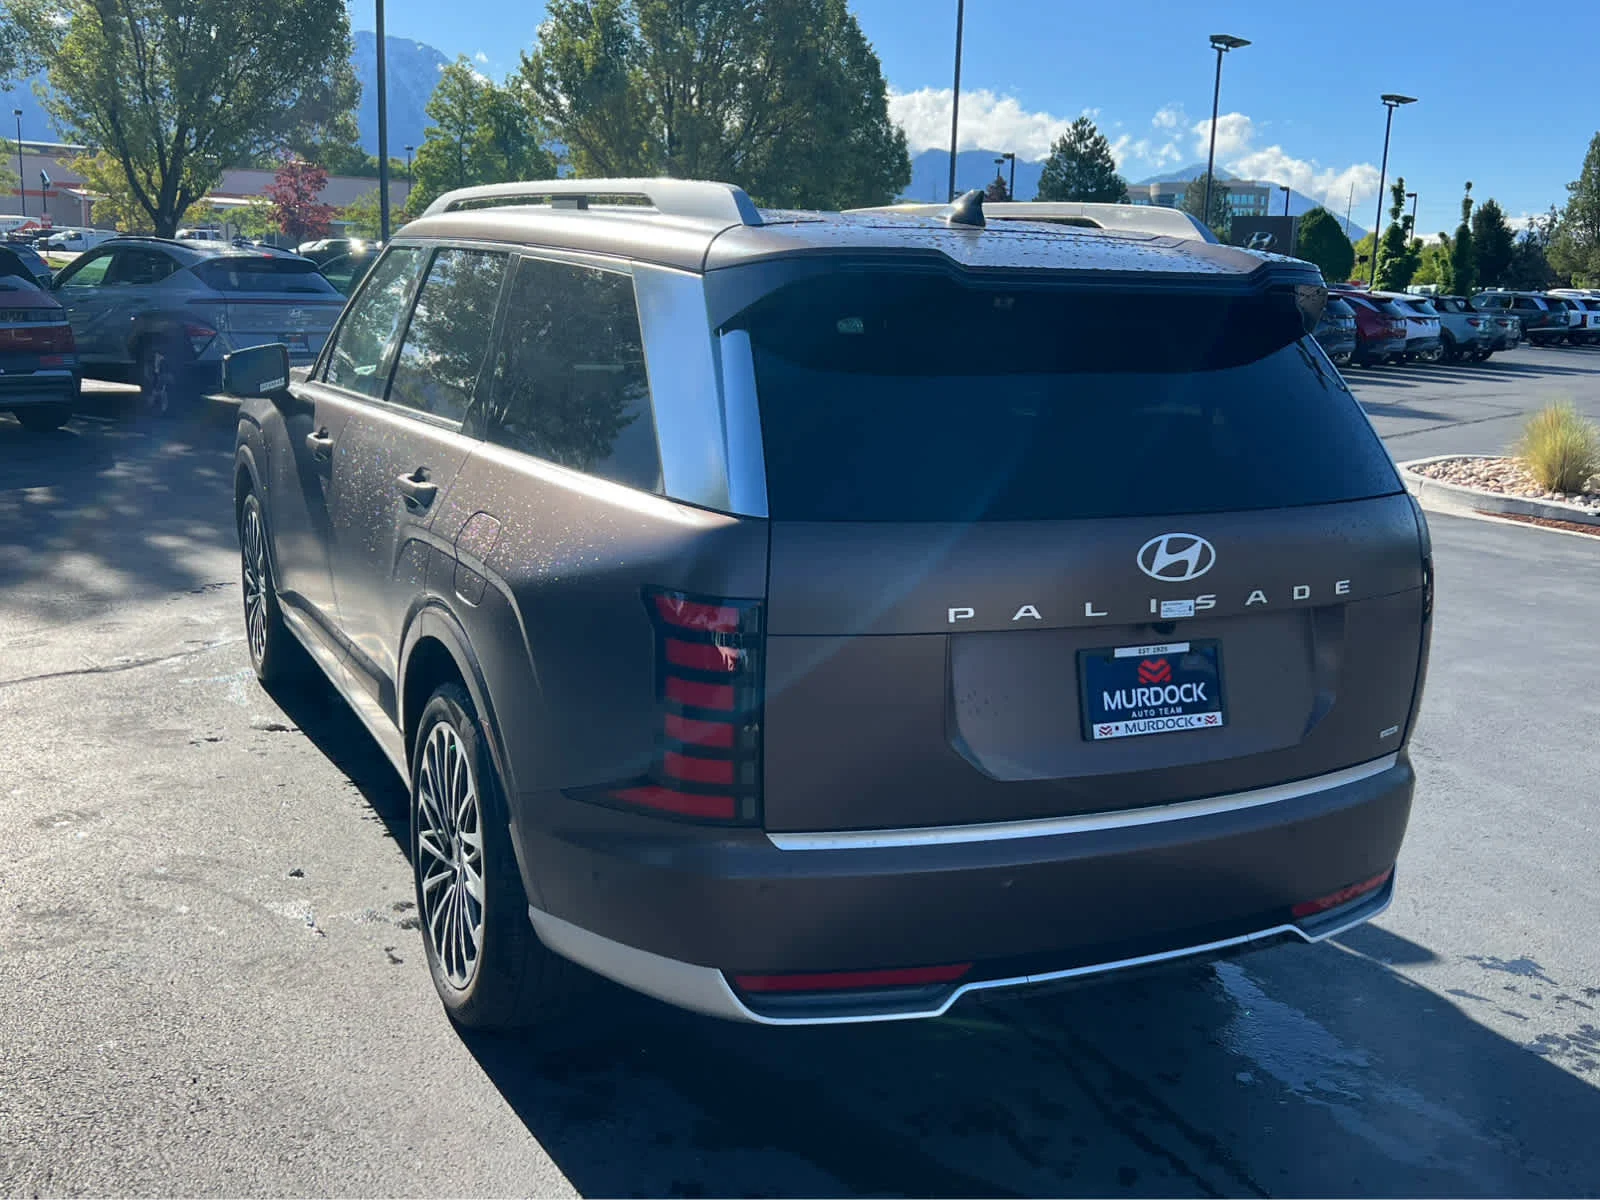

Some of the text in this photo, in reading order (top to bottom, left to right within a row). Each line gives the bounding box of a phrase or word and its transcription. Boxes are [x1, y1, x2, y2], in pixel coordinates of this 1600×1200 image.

[947, 579, 1351, 623] PALISADE
[1103, 682, 1208, 711] MURDOCK
[1131, 706, 1183, 718] AUTO TEAM
[1124, 716, 1195, 734] MURDOCK
